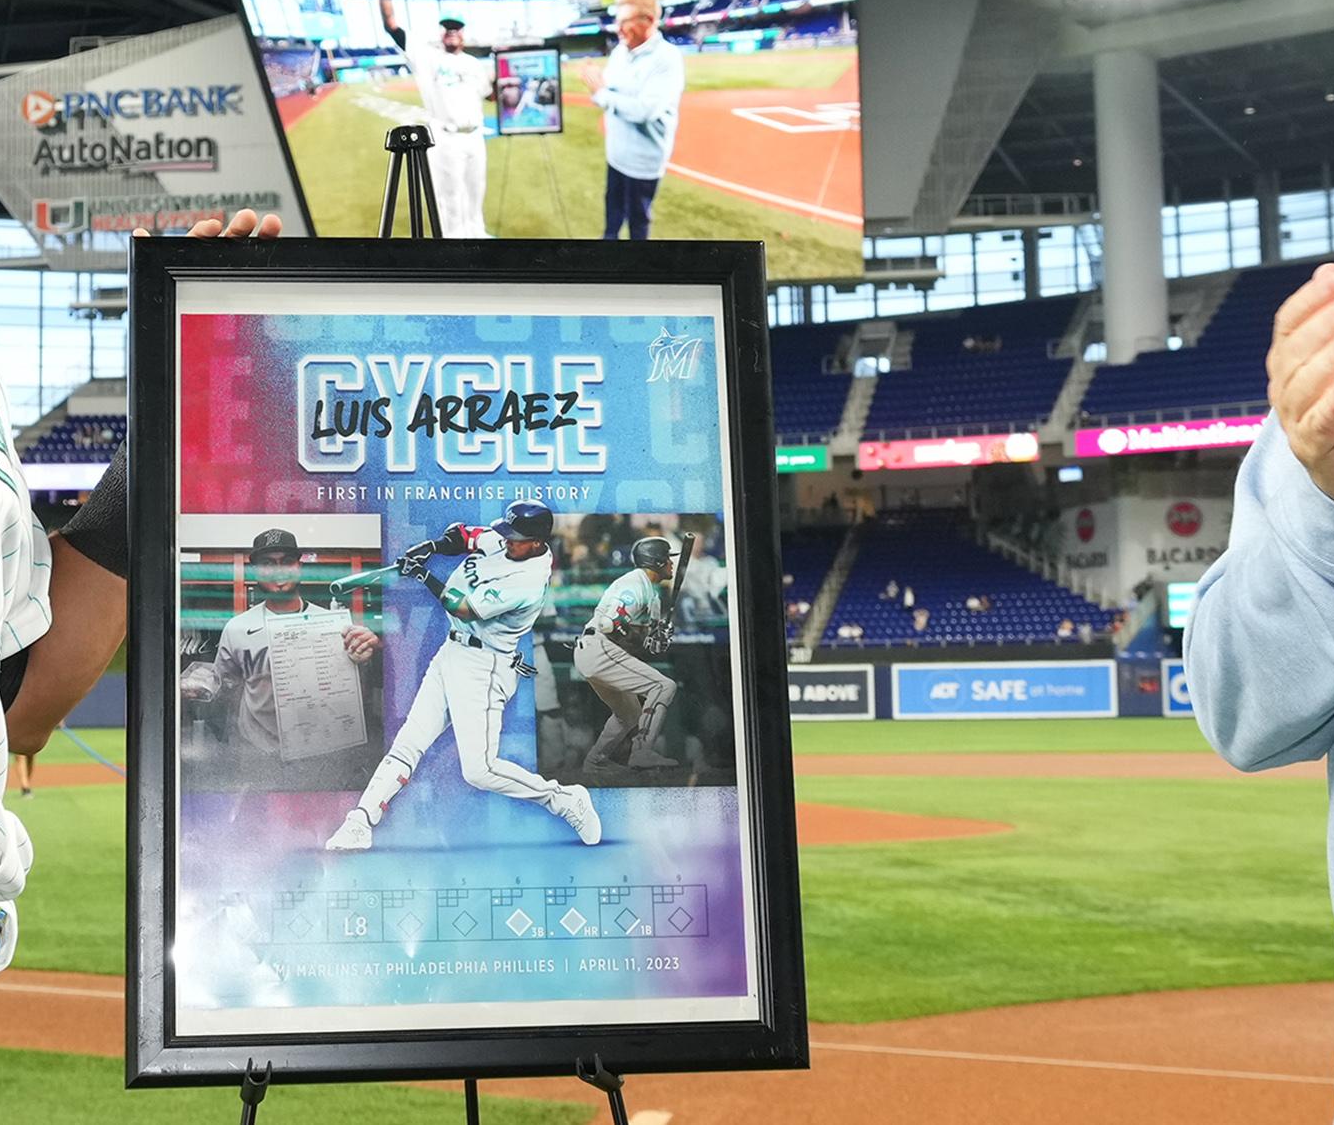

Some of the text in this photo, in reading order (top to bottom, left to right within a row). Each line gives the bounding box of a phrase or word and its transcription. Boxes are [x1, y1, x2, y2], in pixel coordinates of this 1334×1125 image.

[33, 131, 215, 166] AutoNation
[297, 354, 607, 473] CYCLE
[311, 390, 579, 440] LUIS ARRAEZ
[317, 485, 591, 501] FIRST IN FRANCHISE HISTORY
[1146, 546, 1222, 565] BACARD
[802, 683, 860, 702] ABOVE
[971, 680, 1028, 702] SAFE
[344, 916, 368, 937] L8
[584, 926, 598, 937] HR
[296, 962, 359, 978] MARLINS
[364, 962, 381, 976] AT
[386, 960, 488, 976] PHILADELPHIA
[494, 958, 556, 974] PHILLIES
[579, 958, 620, 972] APRIL
[646, 956, 681, 971] 2023
